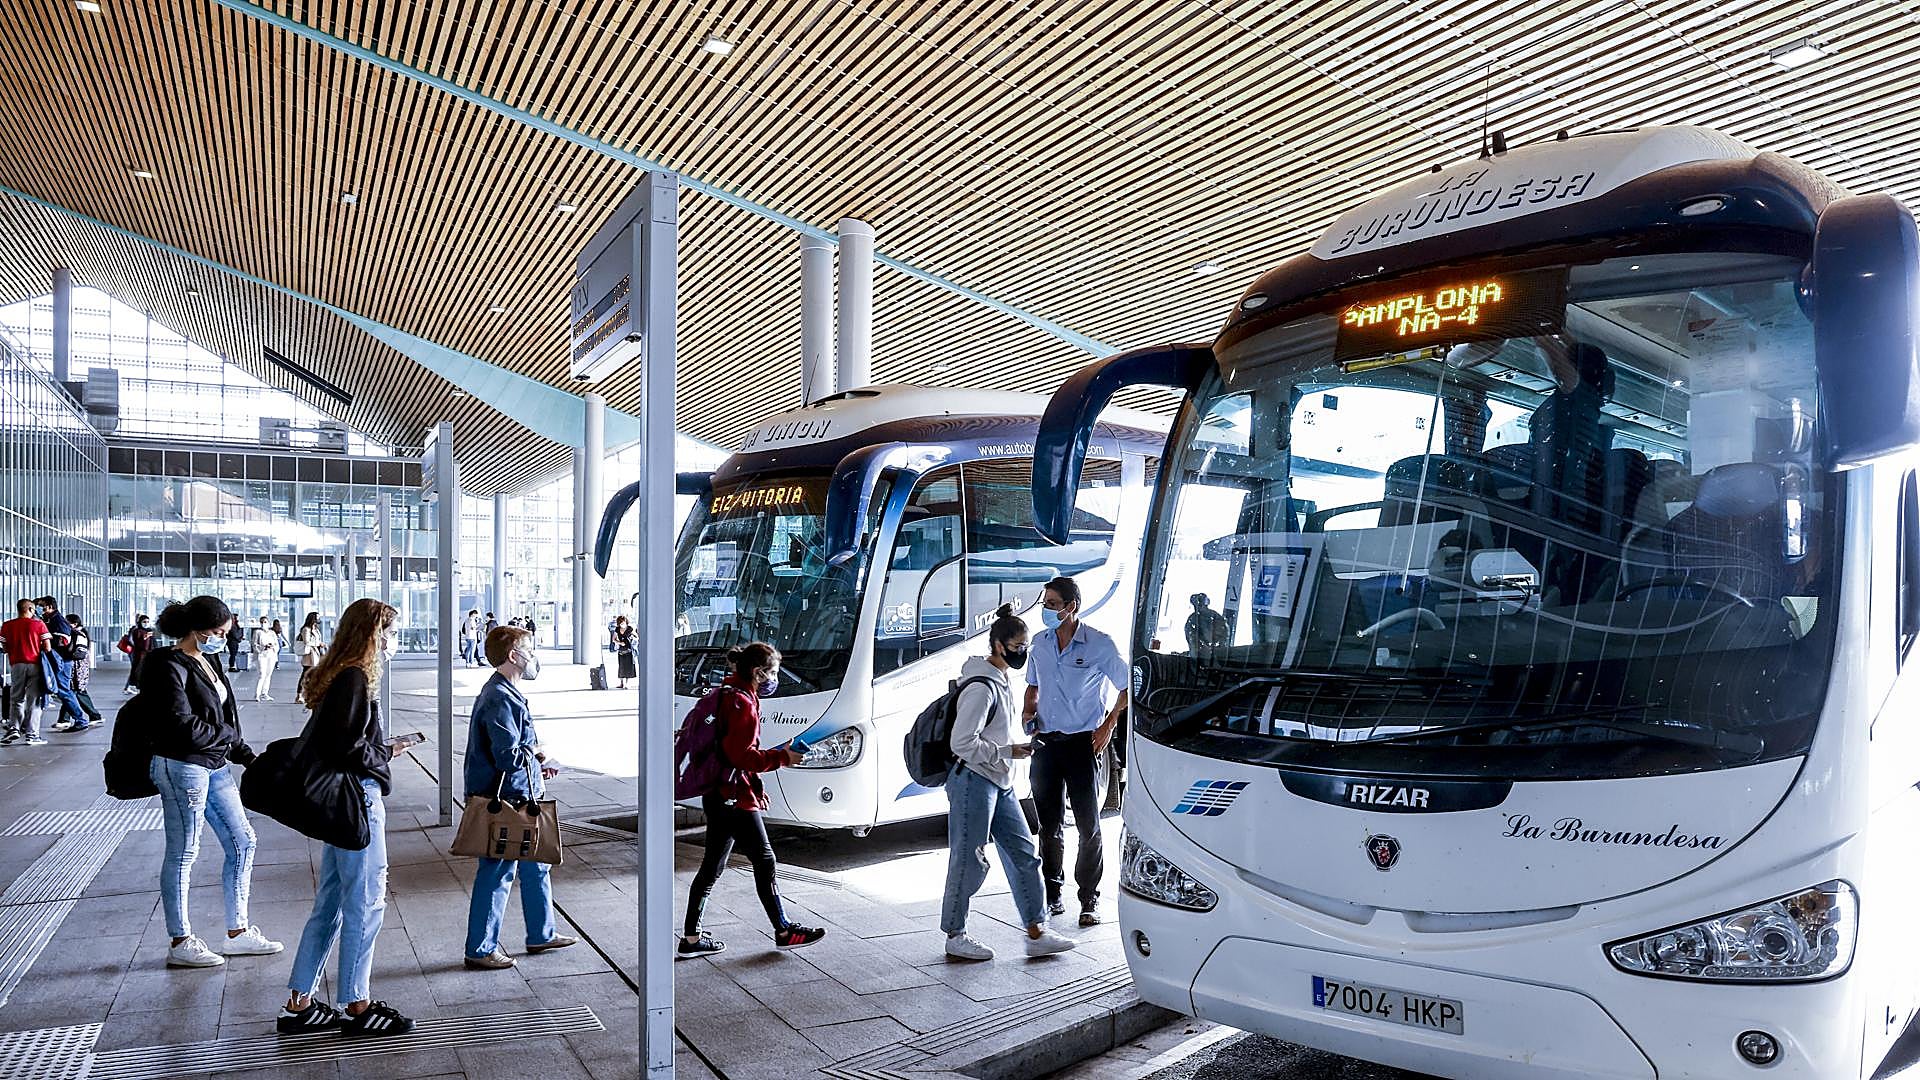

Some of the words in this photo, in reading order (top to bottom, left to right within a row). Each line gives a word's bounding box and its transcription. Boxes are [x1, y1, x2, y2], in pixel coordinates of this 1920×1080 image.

[1416, 168, 1489, 197] LA
[1331, 171, 1595, 254] BURUNDESA
[1399, 305, 1479, 336] NA-4
[763, 419, 832, 443] UNION
[770, 711, 809, 725] Union
[1502, 814, 1547, 839] La
[1550, 817, 1729, 849] Burundesa
[1316, 993, 1322, 1002] E
[1325, 981, 1392, 1018] 7004
[1403, 996, 1456, 1029] HKP
